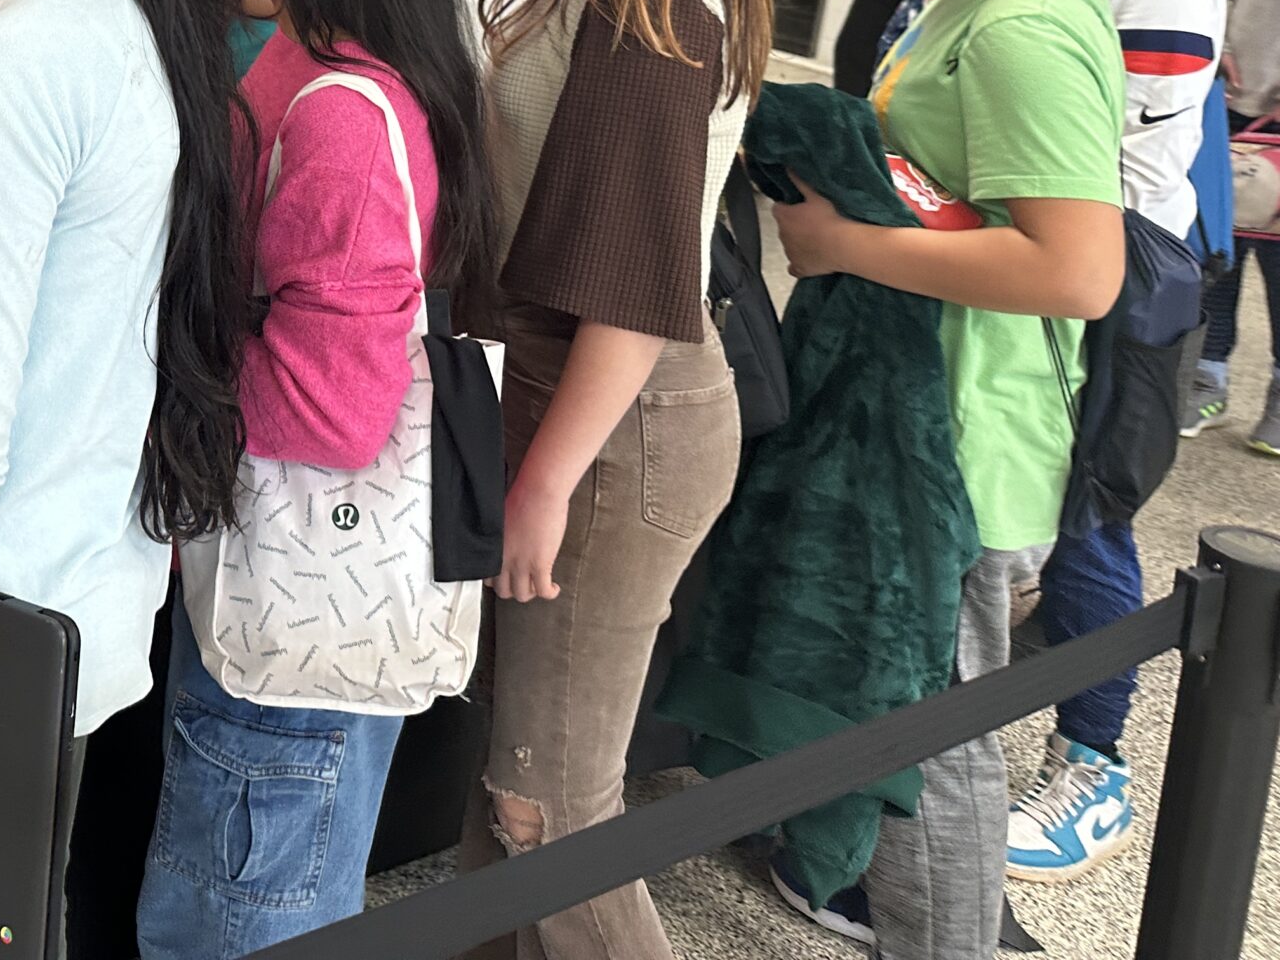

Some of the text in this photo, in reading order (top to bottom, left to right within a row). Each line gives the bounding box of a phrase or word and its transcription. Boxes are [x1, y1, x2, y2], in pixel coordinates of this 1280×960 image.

[257, 541, 288, 555] lululemon
[293, 569, 327, 581] lululemon
[286, 615, 320, 630] lululemon
